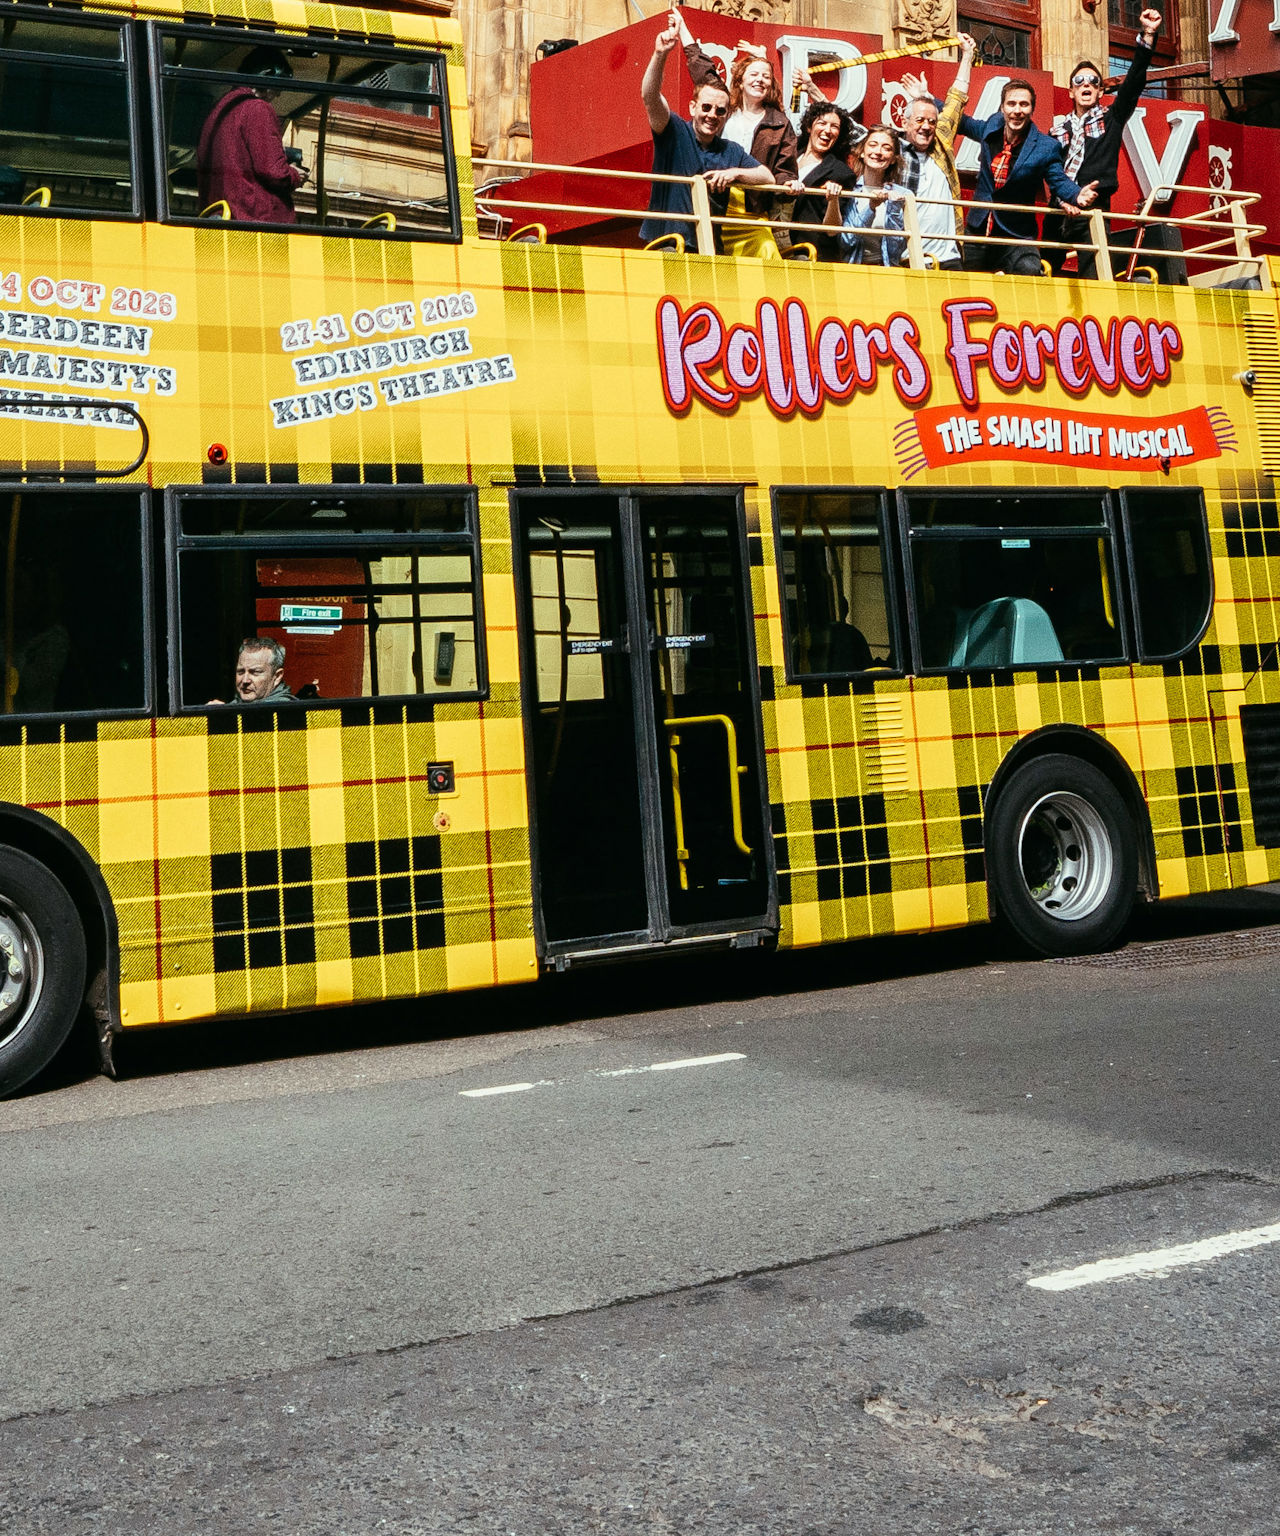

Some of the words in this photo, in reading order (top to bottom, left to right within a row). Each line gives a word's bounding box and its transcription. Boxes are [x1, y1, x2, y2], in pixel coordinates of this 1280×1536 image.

[30, 277, 101, 307] OCT
[111, 287, 173, 316] 2026
[283, 317, 346, 348] 27-31
[354, 303, 413, 334] OCT
[423, 294, 475, 322] 2026
[295, 329, 470, 382] EDINBURGH
[657, 296, 931, 415] Rollers
[942, 297, 1183, 411] Forever
[273, 384, 371, 425] KING'S
[380, 356, 514, 402] THEATRE
[935, 416, 983, 454] THE
[986, 416, 1062, 455] SMASH
[1067, 422, 1104, 457] HIT
[1108, 425, 1194, 459] MUSICAL
[301, 608, 317, 616] Fire
[317, 609, 331, 617] exit
